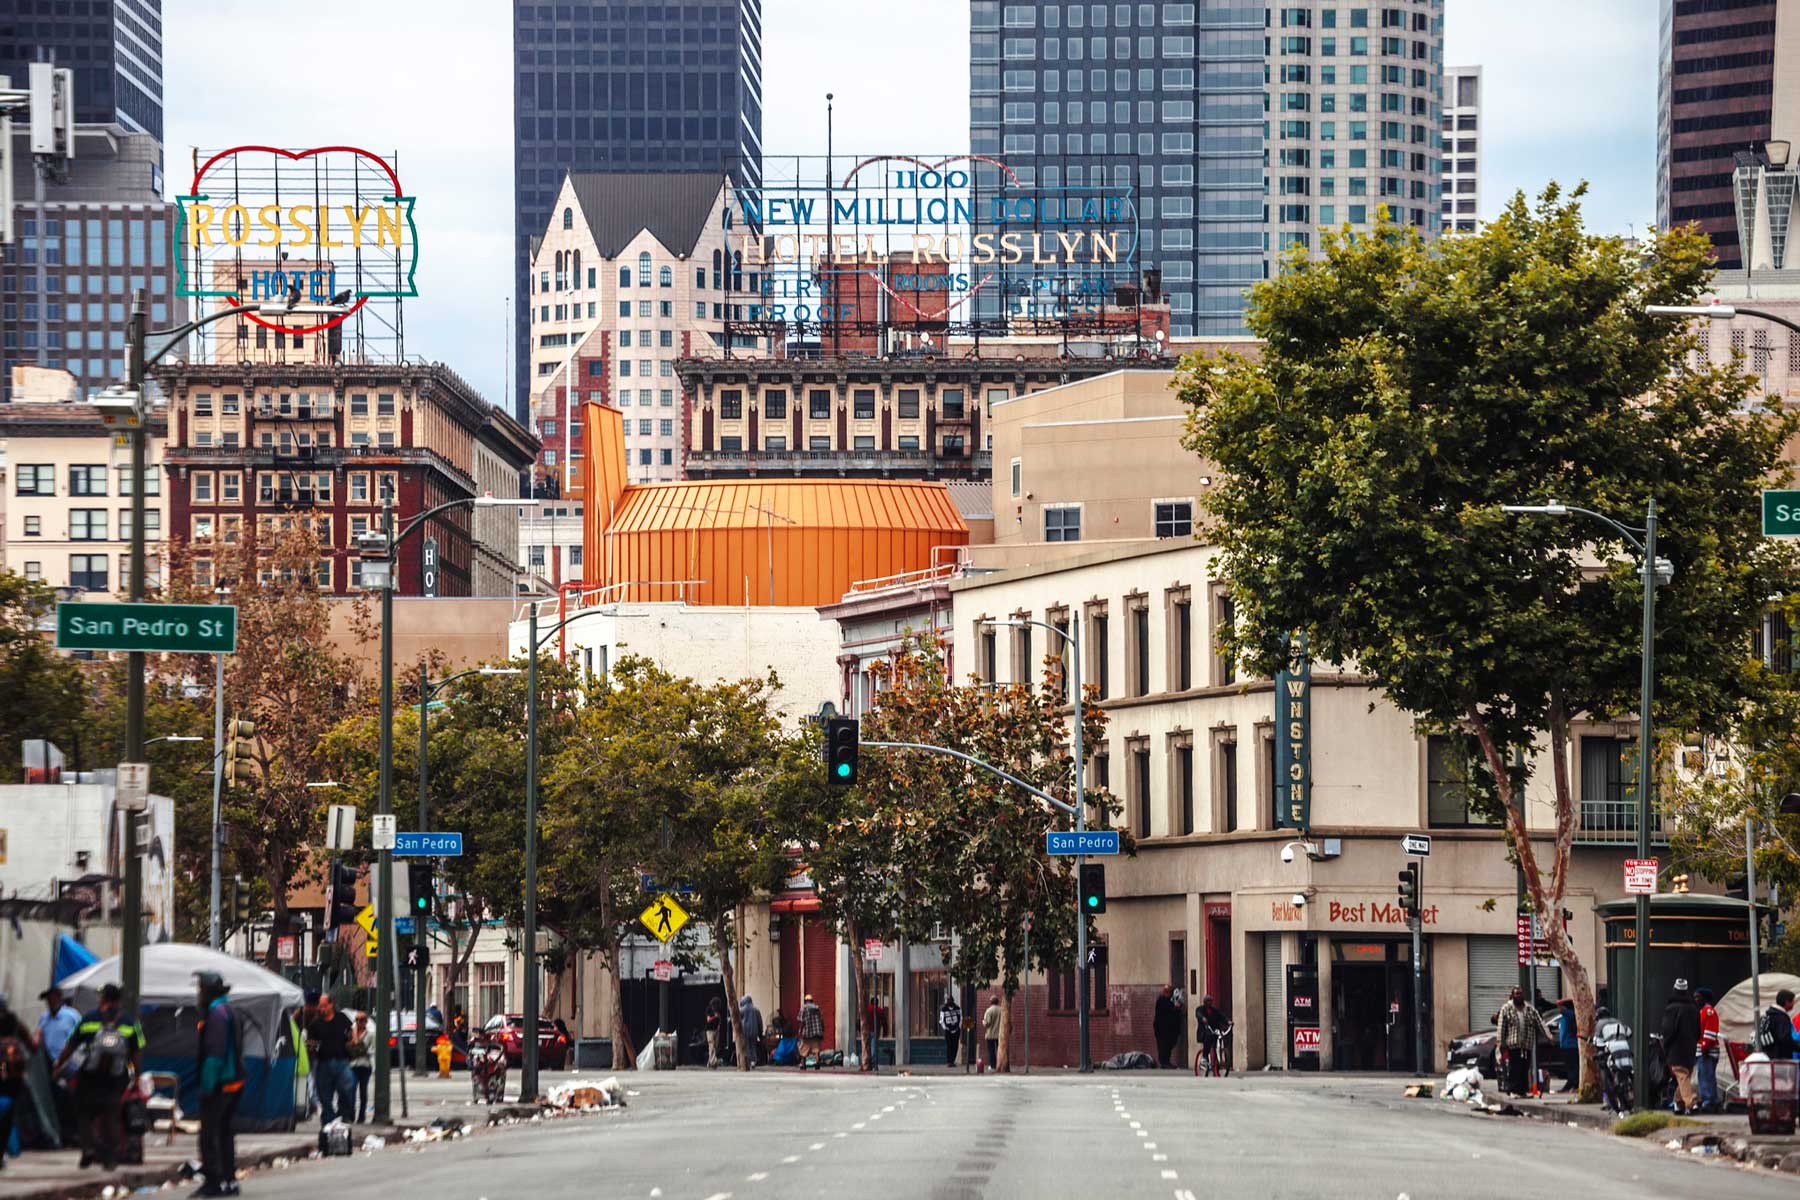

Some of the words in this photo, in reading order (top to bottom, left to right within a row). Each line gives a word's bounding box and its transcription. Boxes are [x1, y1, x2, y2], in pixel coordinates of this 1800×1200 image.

[896, 170, 969, 189] 1100
[742, 198, 815, 225] NEW
[834, 198, 973, 225] MILLION
[991, 197, 1124, 224] DOLLAR
[189, 204, 402, 248] ROSSLYN
[741, 233, 889, 265] HOTEL
[911, 230, 1120, 265] ROSSLYN
[761, 278, 834, 298] FIRE
[895, 272, 969, 292] ROOMS
[1001, 276, 1109, 296] POPULAR
[749, 303, 856, 322] PROOF
[1010, 301, 1098, 321] PRICES
[425, 549, 434, 598] HO
[69, 616, 113, 636] San
[122, 617, 189, 637] Pedro
[198, 618, 224, 638] St
[397, 837, 418, 849] San
[422, 837, 457, 849] Pedro
[1053, 836, 1075, 849] San
[1079, 836, 1114, 848] Pedro
[1625, 867, 1635, 876] NO
[1329, 901, 1366, 922] Best
[1296, 1031, 1320, 1043] ATM
